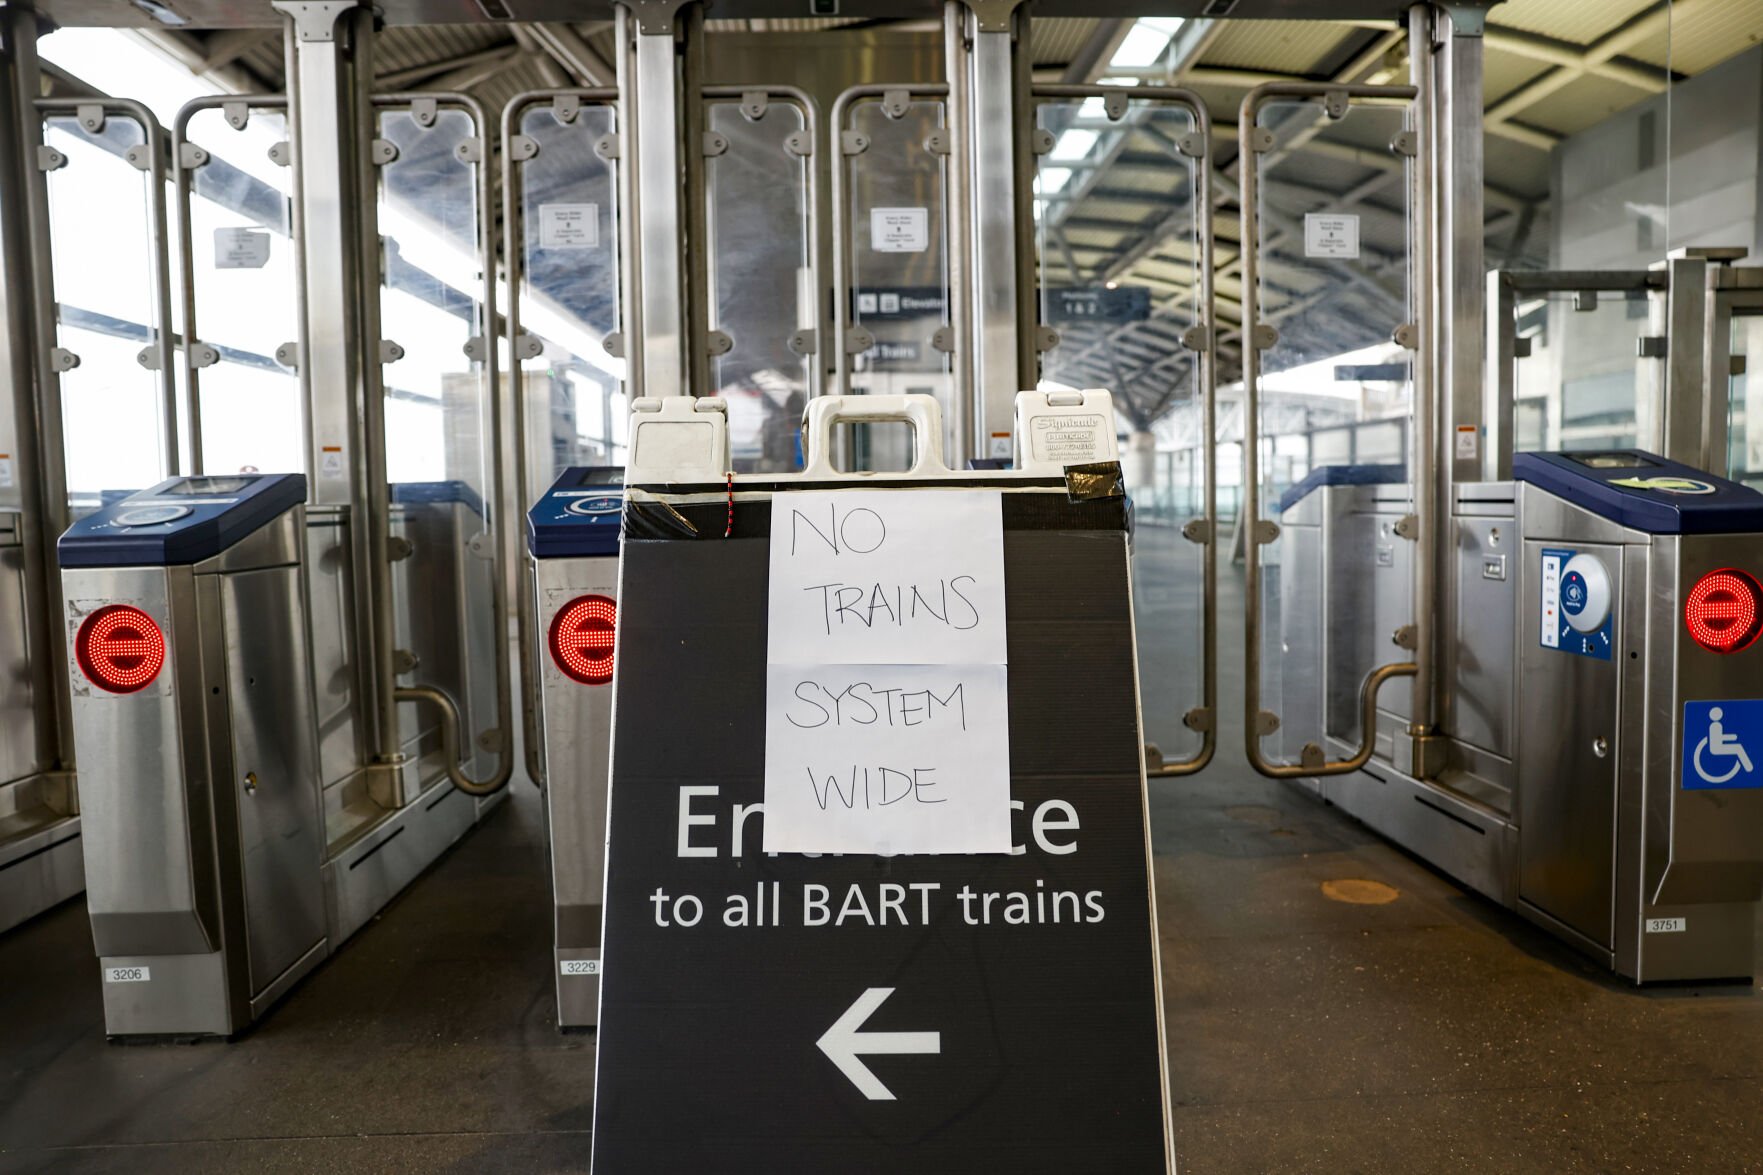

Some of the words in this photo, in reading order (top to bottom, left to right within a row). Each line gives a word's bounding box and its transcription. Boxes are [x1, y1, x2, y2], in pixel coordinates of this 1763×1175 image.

[791, 503, 886, 556] NO
[803, 575, 979, 636] TRAINS
[785, 680, 966, 731] SYSTEM
[807, 764, 948, 810] WIDE
[649, 887, 703, 928] to
[722, 881, 780, 928] all
[803, 882, 941, 927] BART
[956, 879, 1105, 925] trains
[1652, 919, 1677, 931] 3751
[112, 968, 142, 981] 3206
[567, 961, 596, 973] 3229
